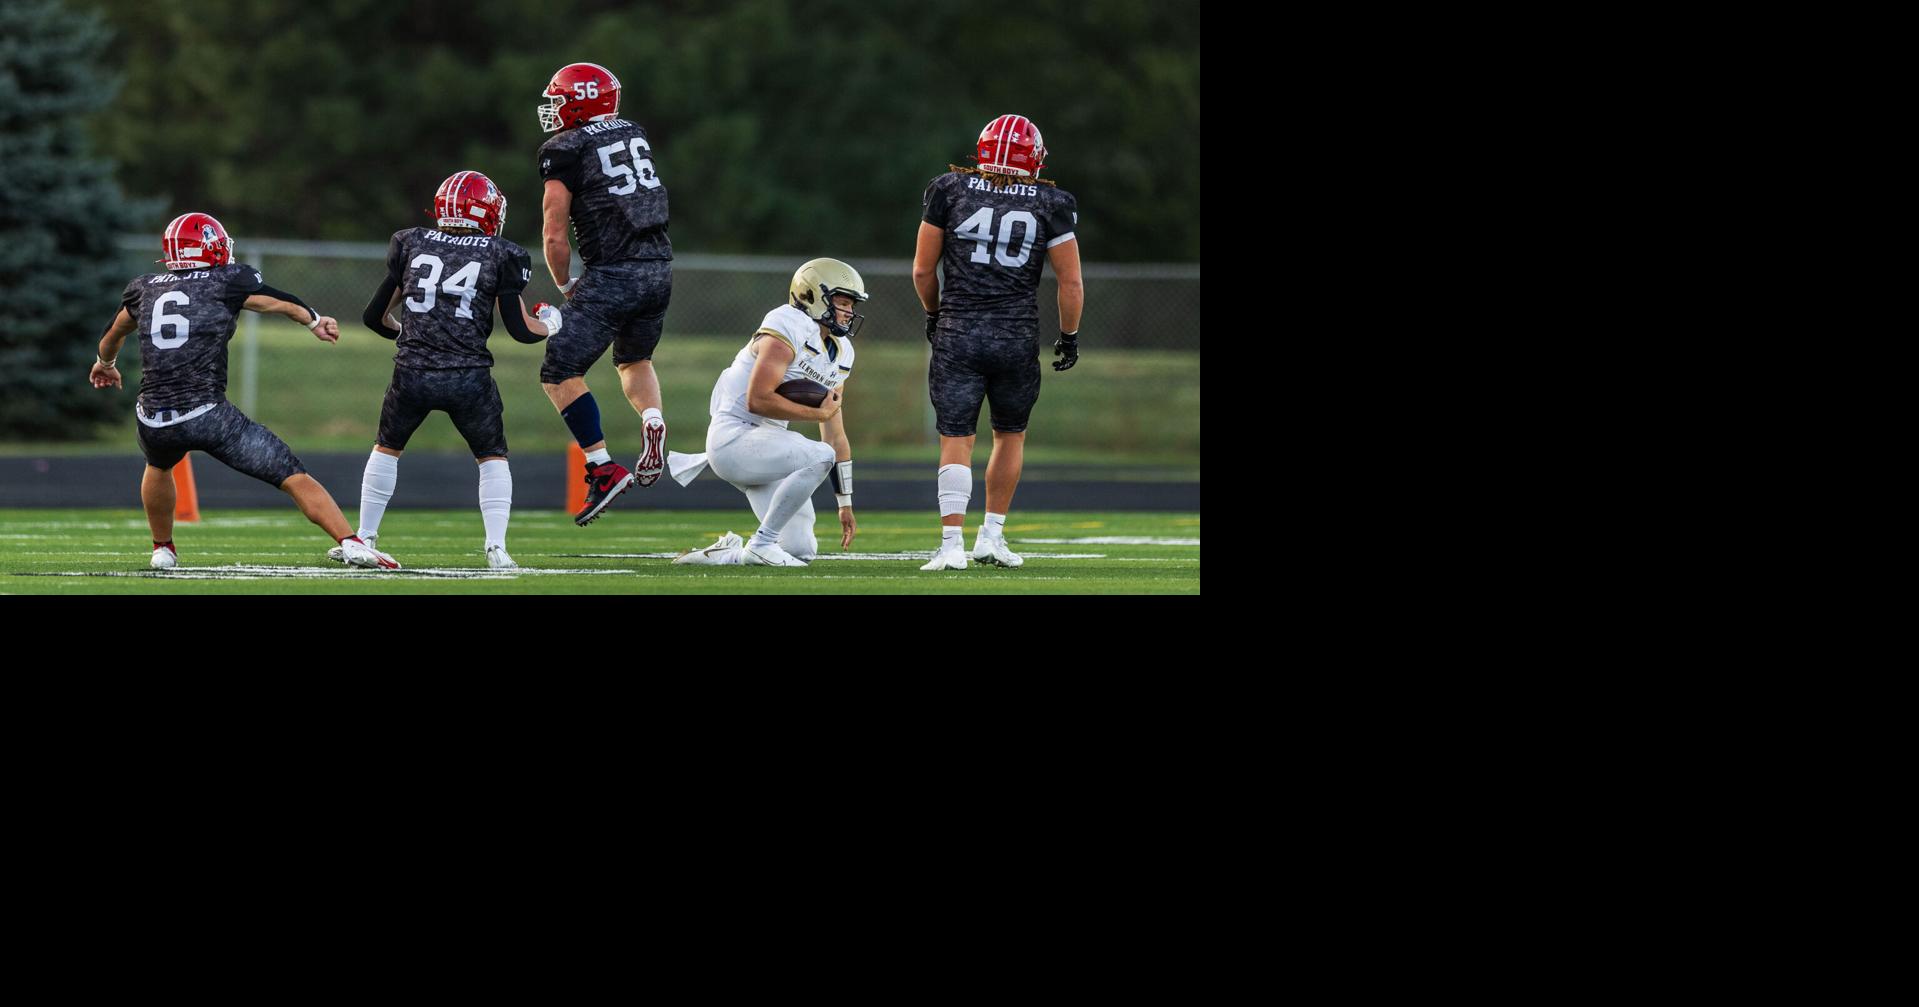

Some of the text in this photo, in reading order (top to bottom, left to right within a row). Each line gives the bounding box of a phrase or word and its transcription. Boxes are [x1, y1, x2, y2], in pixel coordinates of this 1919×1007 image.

[573, 81, 599, 100] 56
[596, 137, 661, 196] 56
[983, 164, 1019, 176] SOUTH BOYZ
[424, 230, 491, 248] PATRIOTS
[953, 207, 1037, 267] 40
[406, 254, 481, 319] 34
[150, 291, 190, 349] 6
[798, 360, 825, 382] ELKHORN
